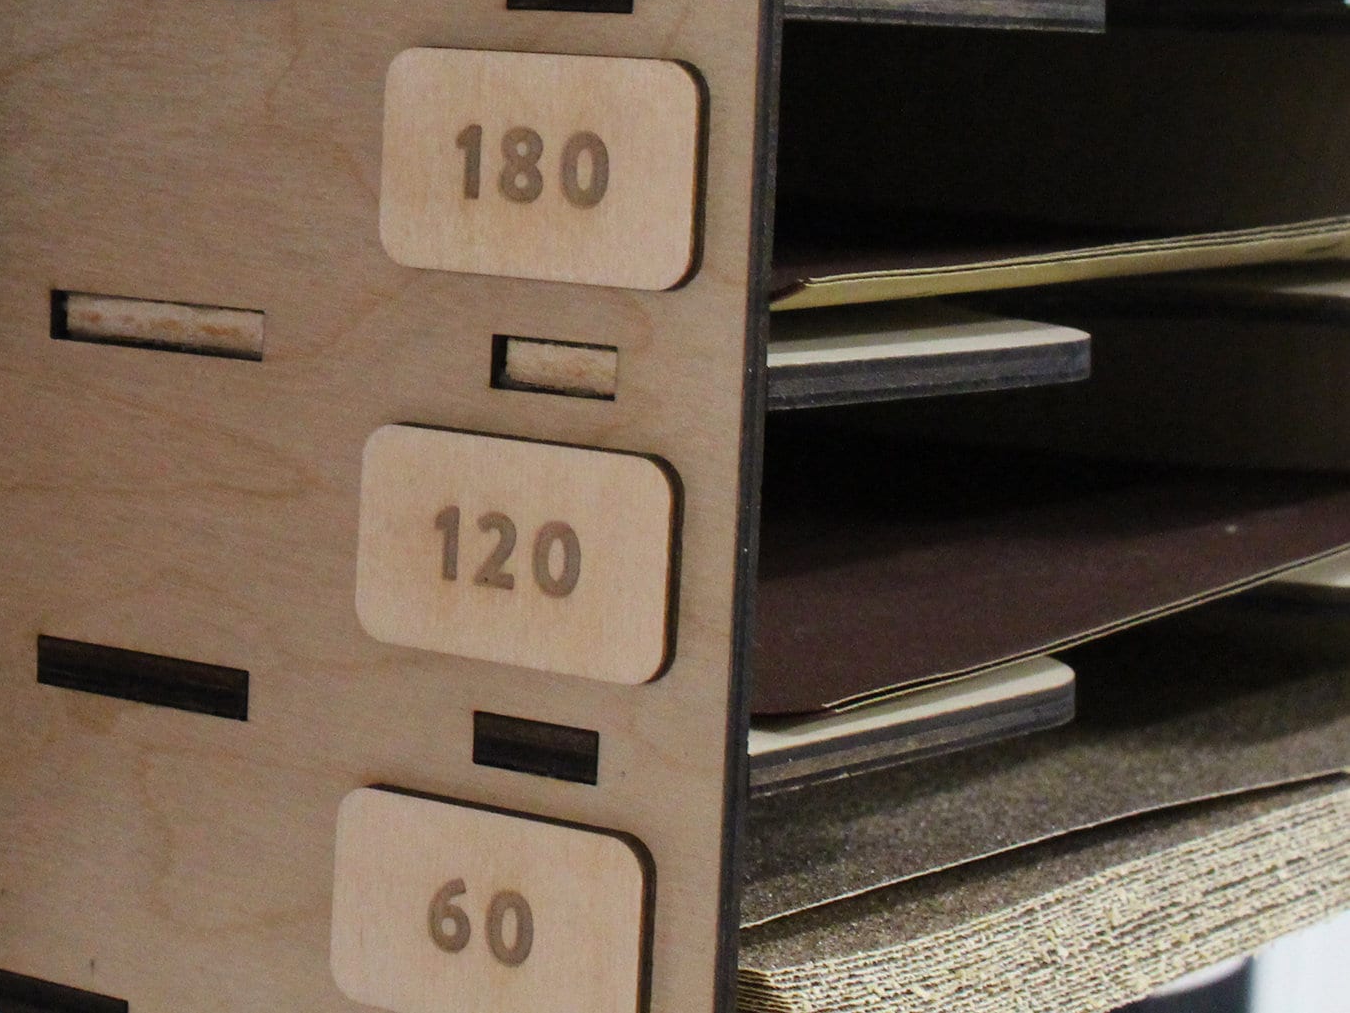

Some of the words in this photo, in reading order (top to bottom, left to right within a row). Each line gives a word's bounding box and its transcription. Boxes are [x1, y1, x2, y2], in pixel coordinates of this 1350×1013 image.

[454, 122, 610, 209] 180
[433, 504, 582, 599] 120
[427, 877, 535, 968] 60
